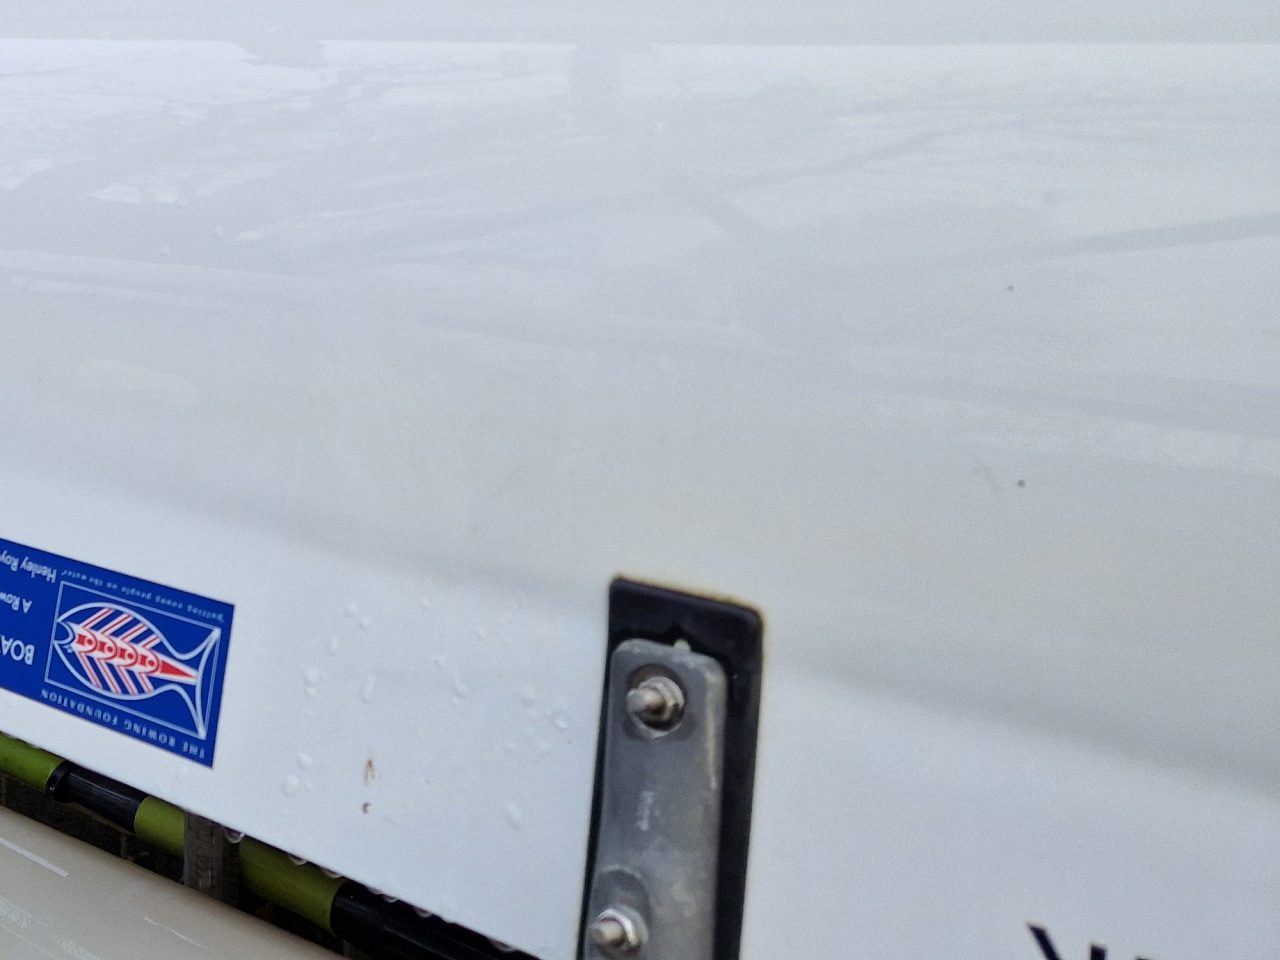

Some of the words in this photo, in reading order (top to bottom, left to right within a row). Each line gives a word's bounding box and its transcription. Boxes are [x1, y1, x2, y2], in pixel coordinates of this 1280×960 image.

[19, 562, 57, 583] Henley
[89, 577, 104, 586] the
[106, 581, 118, 590] on
[121, 586, 153, 600] people
[22, 600, 32, 614] A
[41, 688, 119, 725] FOUNDATION
[123, 719, 176, 748] ROWING
[182, 742, 205, 759] THE
